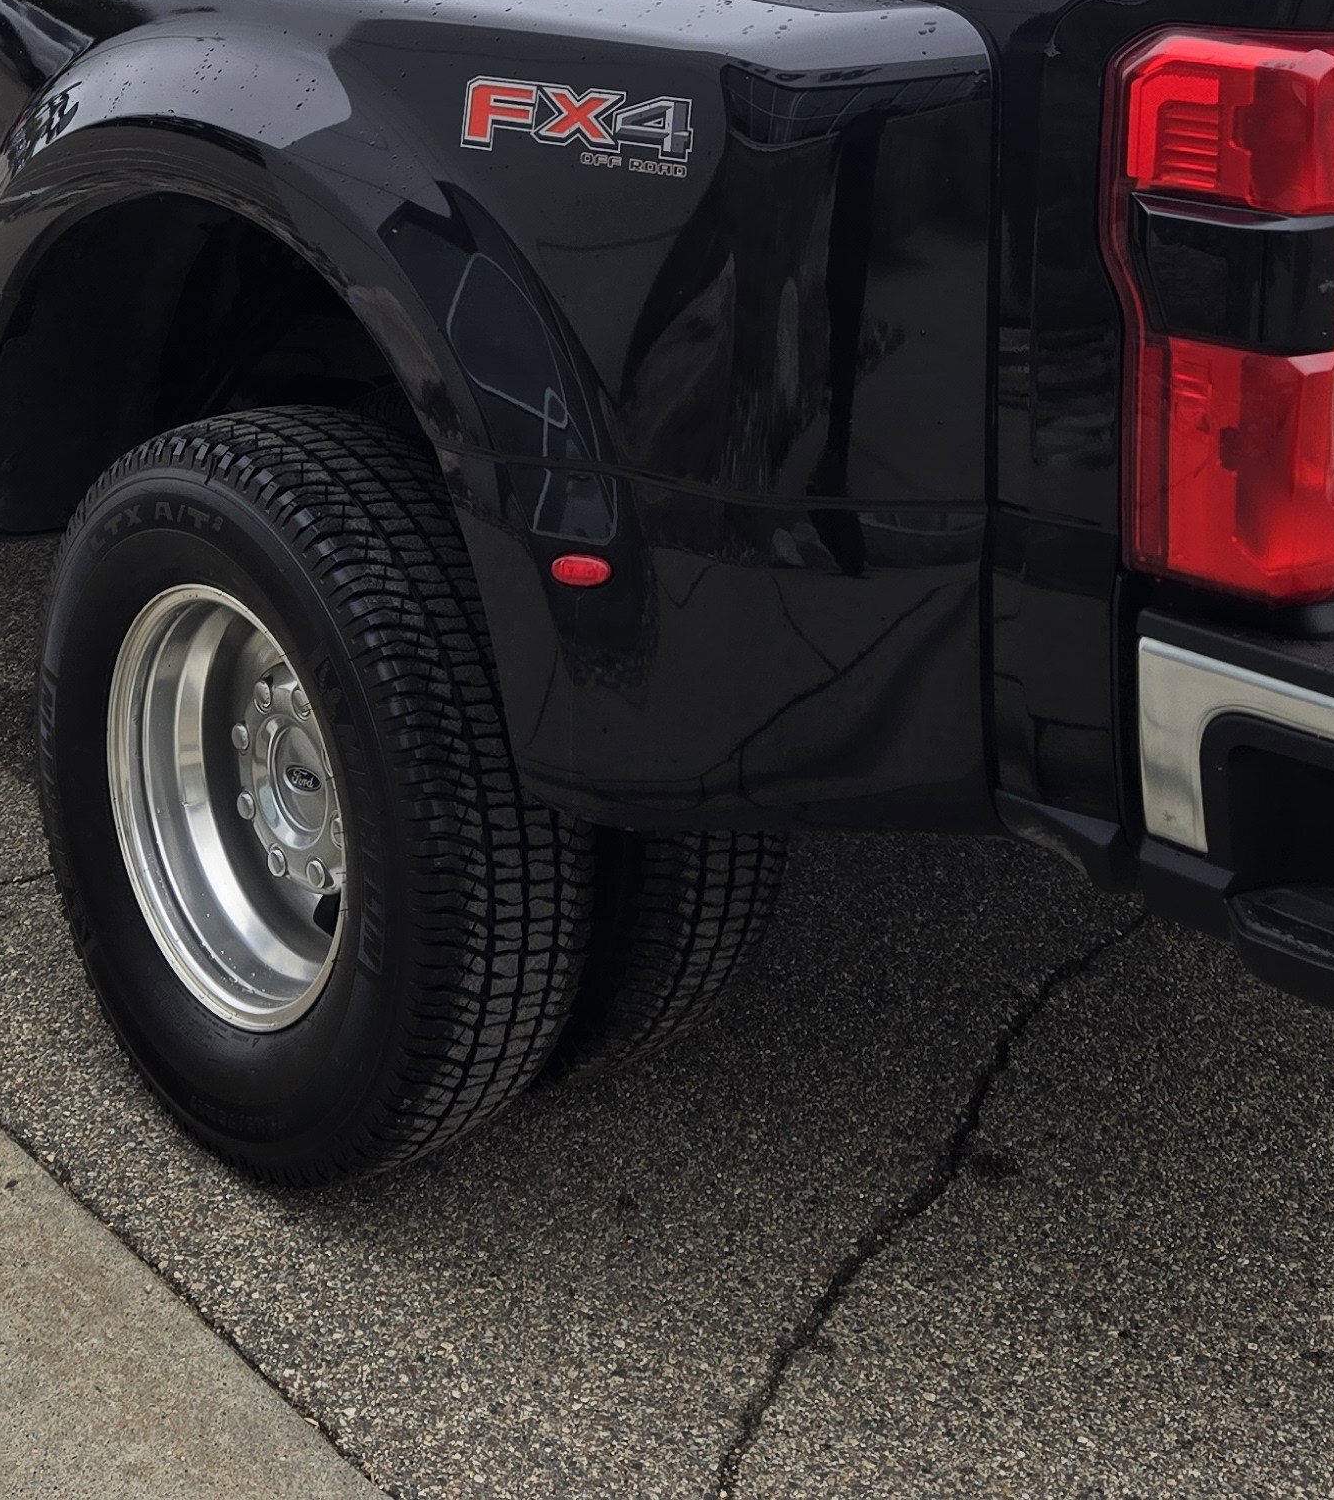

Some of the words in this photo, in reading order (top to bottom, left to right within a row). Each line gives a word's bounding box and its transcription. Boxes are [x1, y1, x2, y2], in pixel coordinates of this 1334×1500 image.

[460, 75, 693, 162] FX4
[580, 152, 622, 168] OFF
[628, 157, 687, 178] ROAD
[291, 770, 314, 789] Ford
